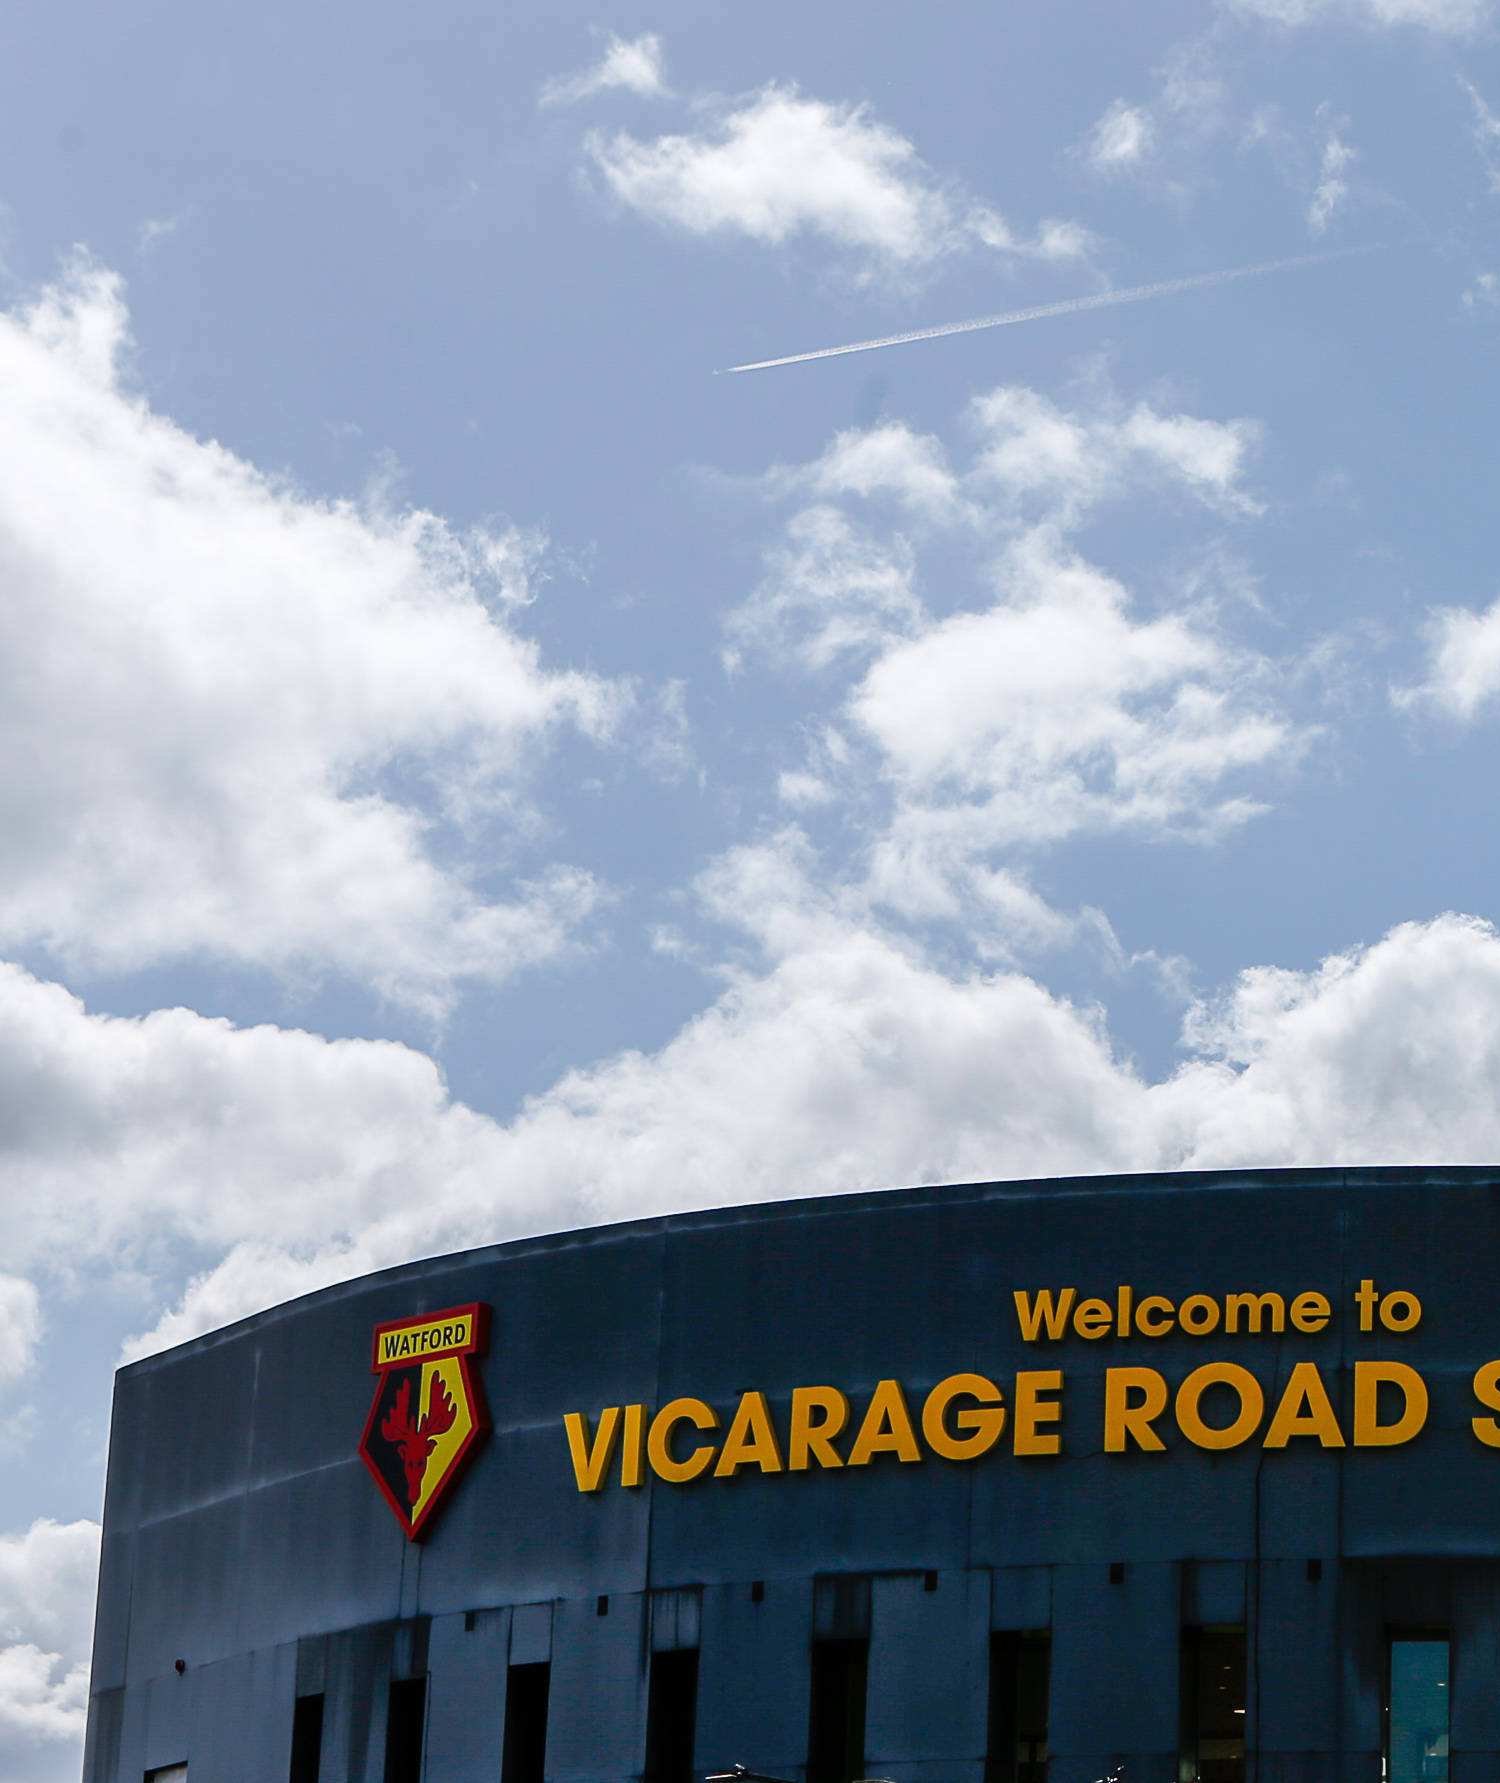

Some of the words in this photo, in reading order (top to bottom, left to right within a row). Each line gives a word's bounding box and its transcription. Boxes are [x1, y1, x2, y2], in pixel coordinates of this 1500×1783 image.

[385, 1323, 466, 1358] WATFORD
[1014, 1285, 1331, 1341] Welcome
[1355, 1280, 1421, 1333] to
[563, 1370, 1063, 1493] VICARAGE
[1104, 1361, 1429, 1453] ROAD
